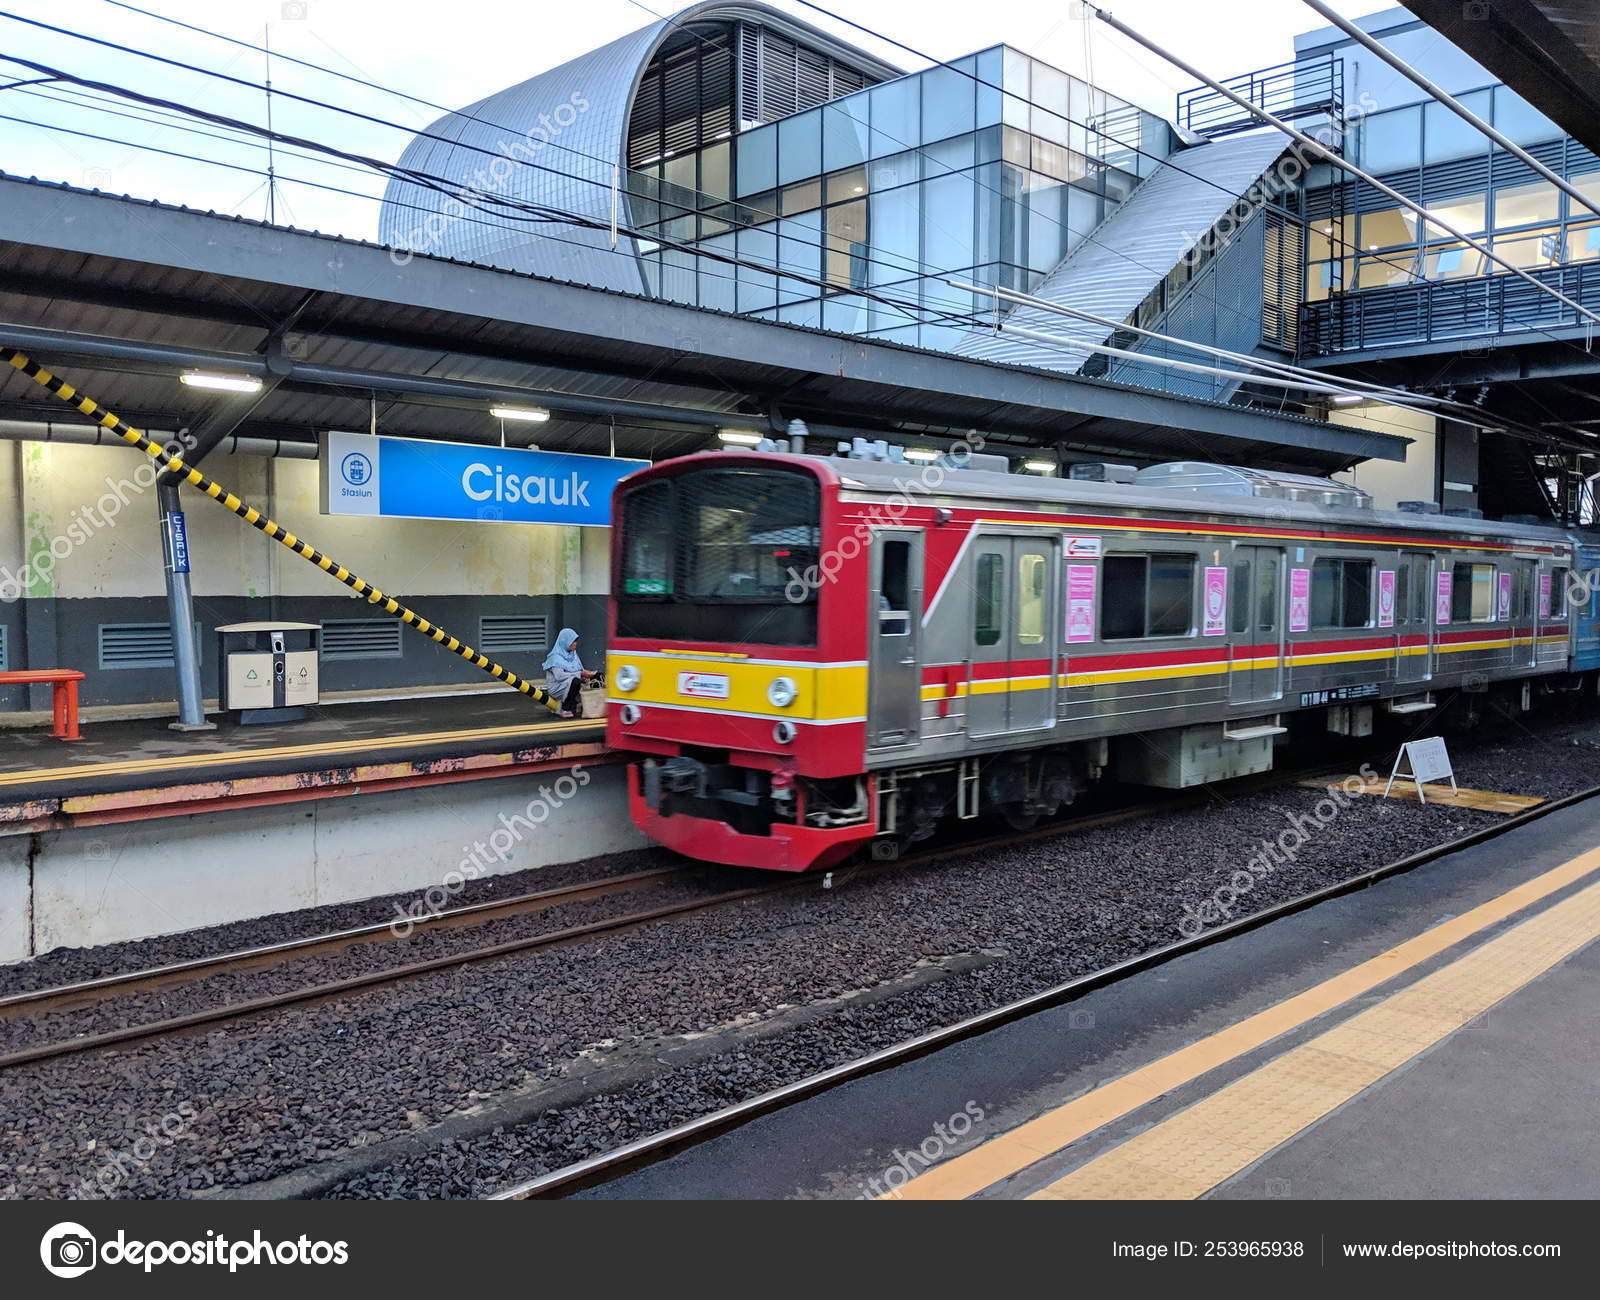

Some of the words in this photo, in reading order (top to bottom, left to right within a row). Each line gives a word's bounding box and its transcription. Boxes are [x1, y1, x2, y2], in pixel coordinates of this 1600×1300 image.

[341, 487, 373, 498] Stasiun
[462, 463, 591, 507] Cisauk
[173, 515, 187, 567] CISAUK
